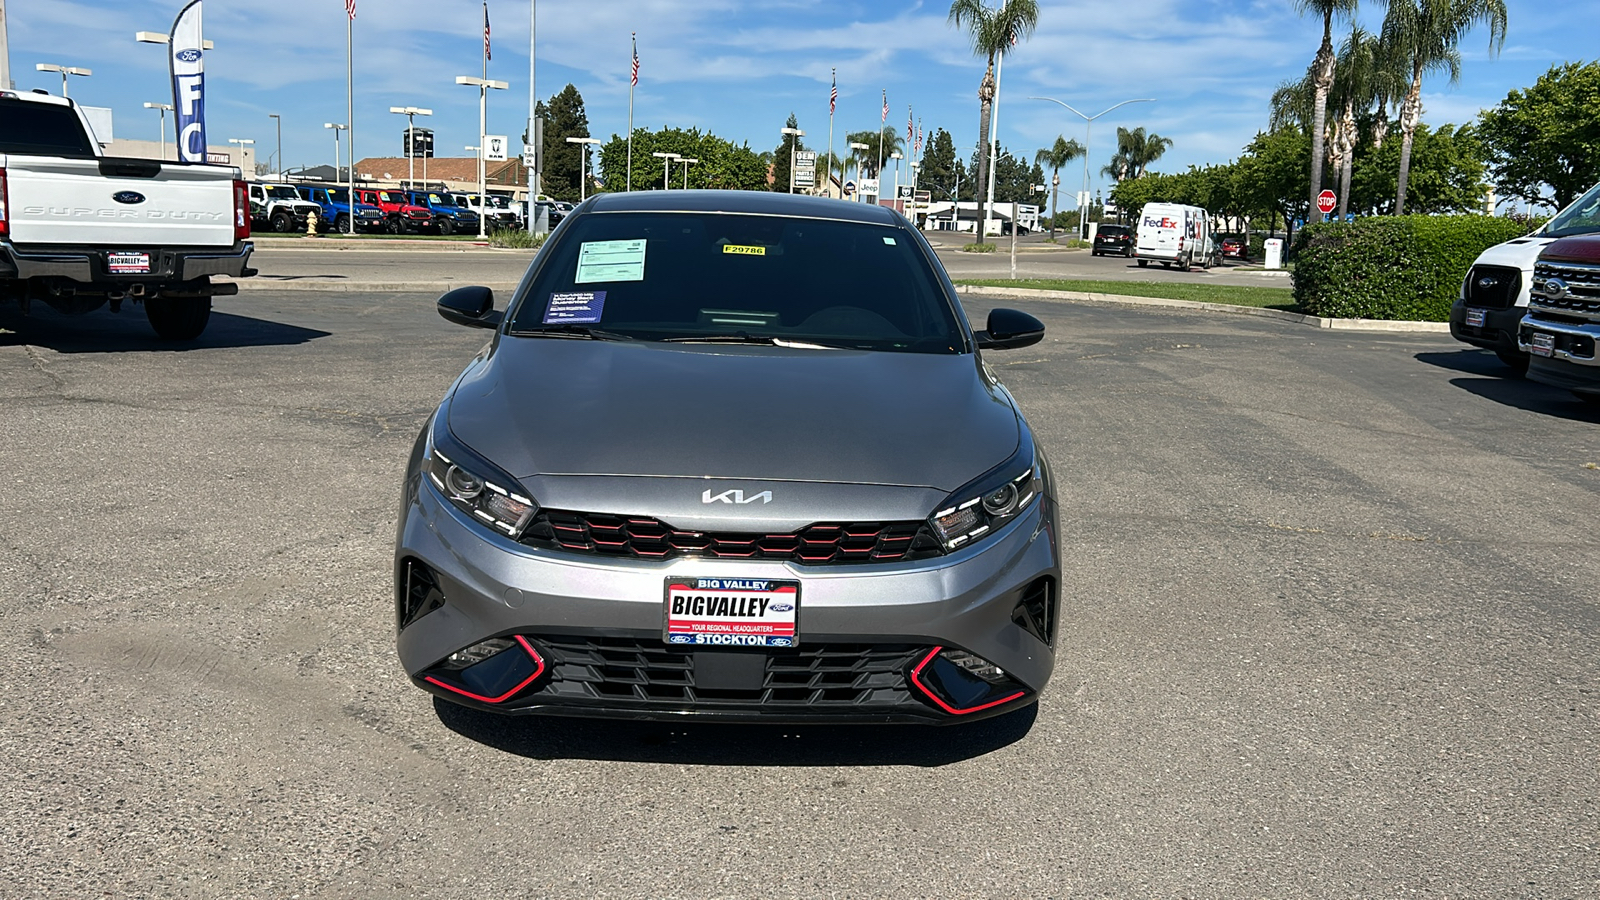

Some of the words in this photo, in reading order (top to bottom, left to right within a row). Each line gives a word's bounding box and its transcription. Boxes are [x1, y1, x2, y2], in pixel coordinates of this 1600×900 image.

[796, 152, 814, 160] OEM
[861, 184, 878, 192] Jeep
[1318, 197, 1335, 206] STOP
[24, 206, 139, 218] SUPER
[147, 209, 223, 220] DUTY
[1143, 216, 1178, 229] FedEx
[725, 246, 763, 254] F29786
[702, 488, 772, 504] KIA
[698, 579, 720, 588] BIG
[722, 580, 768, 590] VALLEY
[671, 595, 770, 617] BIGVALLEY
[771, 603, 791, 612] Ford
[706, 624, 732, 632] REGIONAL
[695, 633, 767, 645] STOCKTON
